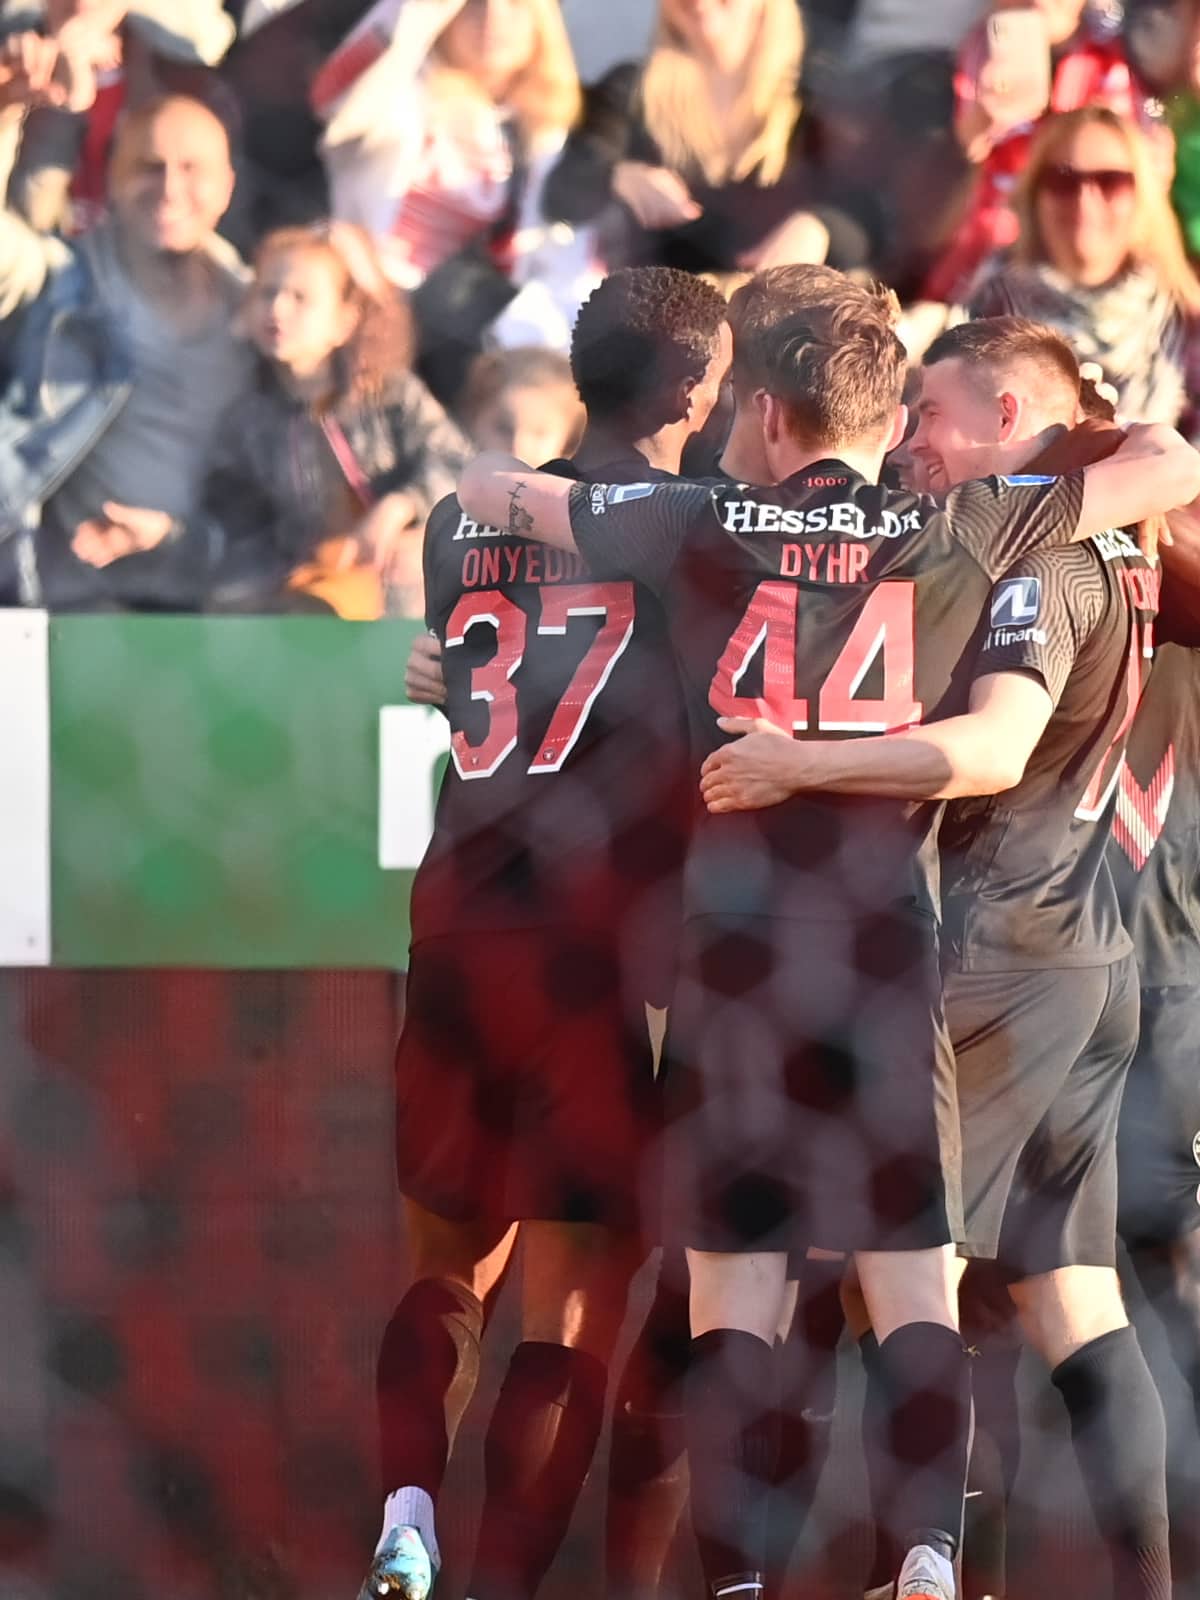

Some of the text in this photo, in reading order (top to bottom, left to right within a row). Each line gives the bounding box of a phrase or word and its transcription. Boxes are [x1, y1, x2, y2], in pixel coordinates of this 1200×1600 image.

[779, 543, 870, 584] DYHR
[445, 581, 635, 781] 37
[708, 580, 923, 740] 44
